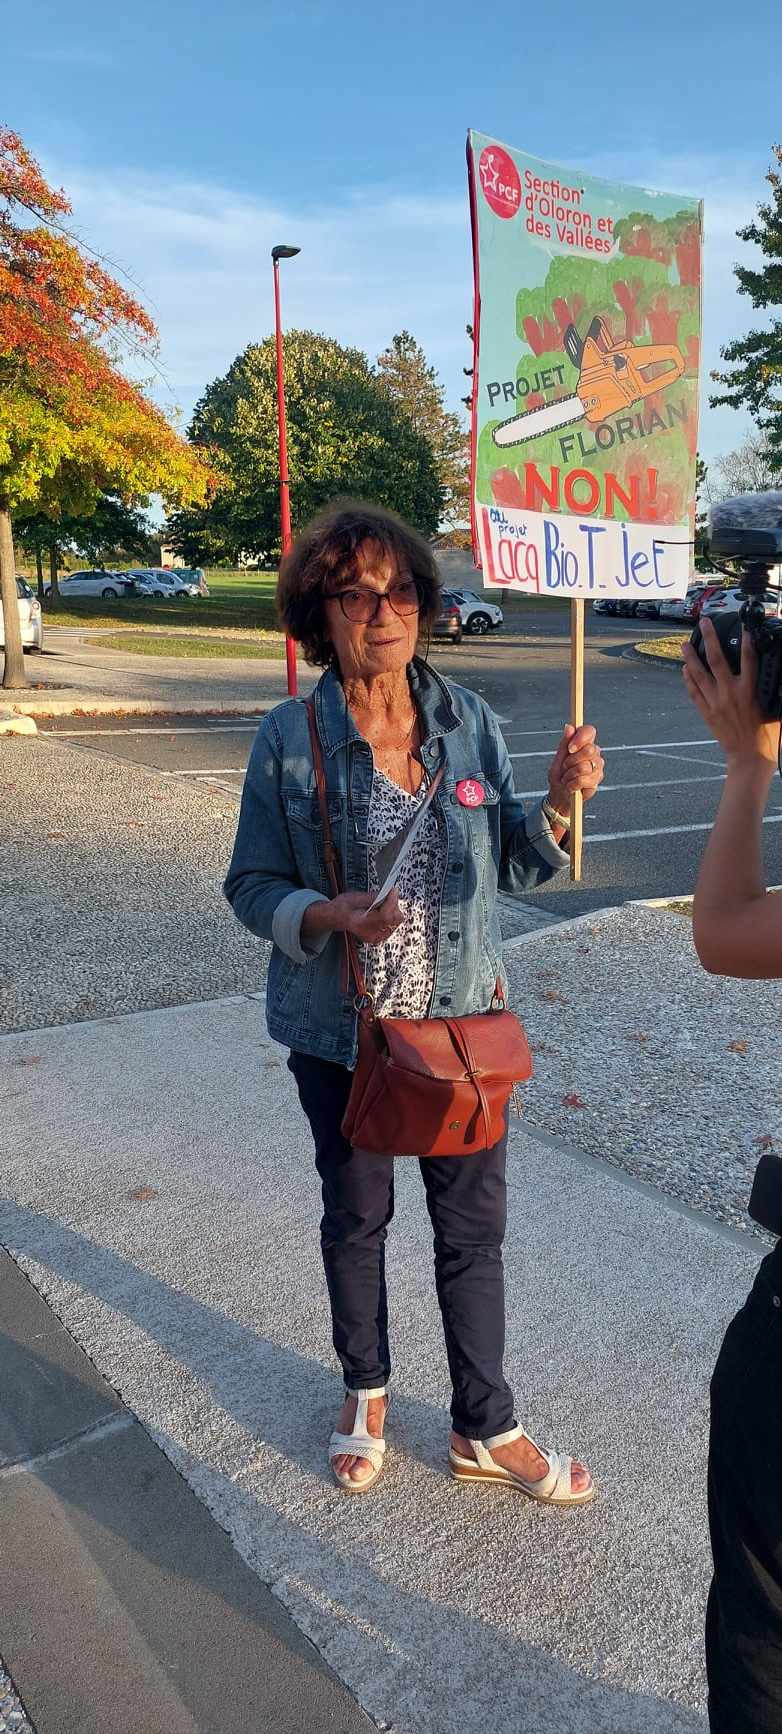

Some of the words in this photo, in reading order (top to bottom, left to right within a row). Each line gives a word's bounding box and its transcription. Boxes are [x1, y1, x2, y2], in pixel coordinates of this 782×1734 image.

[498, 183, 519, 201] PCF
[525, 170, 580, 204] Section
[525, 193, 591, 228] d'Oloron
[597, 217, 614, 234] et
[526, 215, 551, 238] des
[557, 227, 611, 253] Vallées
[558, 399, 689, 463] FLORIAN
[524, 463, 658, 520] NON!
[481, 507, 539, 592] Lacq
